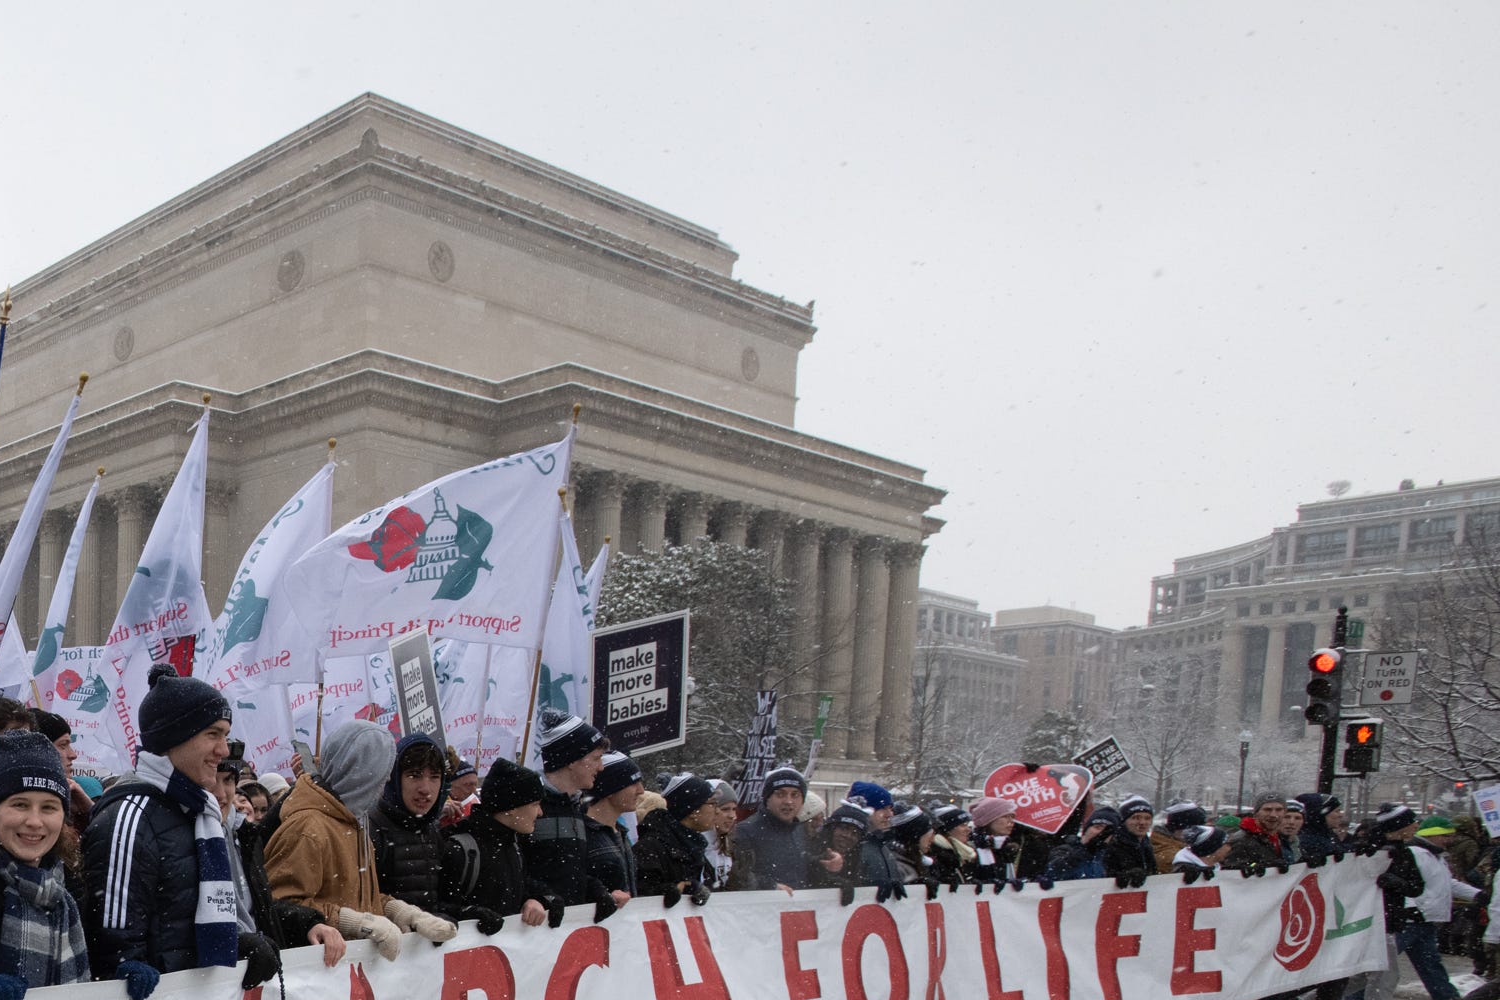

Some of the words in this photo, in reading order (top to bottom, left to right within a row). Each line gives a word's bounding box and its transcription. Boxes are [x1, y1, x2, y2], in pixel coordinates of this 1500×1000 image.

[611, 647, 654, 673] make
[1380, 655, 1404, 667] NO
[403, 666, 422, 686] make
[1376, 668, 1406, 678] TURN
[610, 670, 653, 696] more
[1366, 680, 1382, 689] ON
[1388, 678, 1410, 688] RED
[407, 690, 426, 709] more
[610, 697, 667, 723] babies.
[22, 776, 33, 787] WE
[33, 777, 46, 788] ARE
[994, 777, 1038, 798] LOVE
